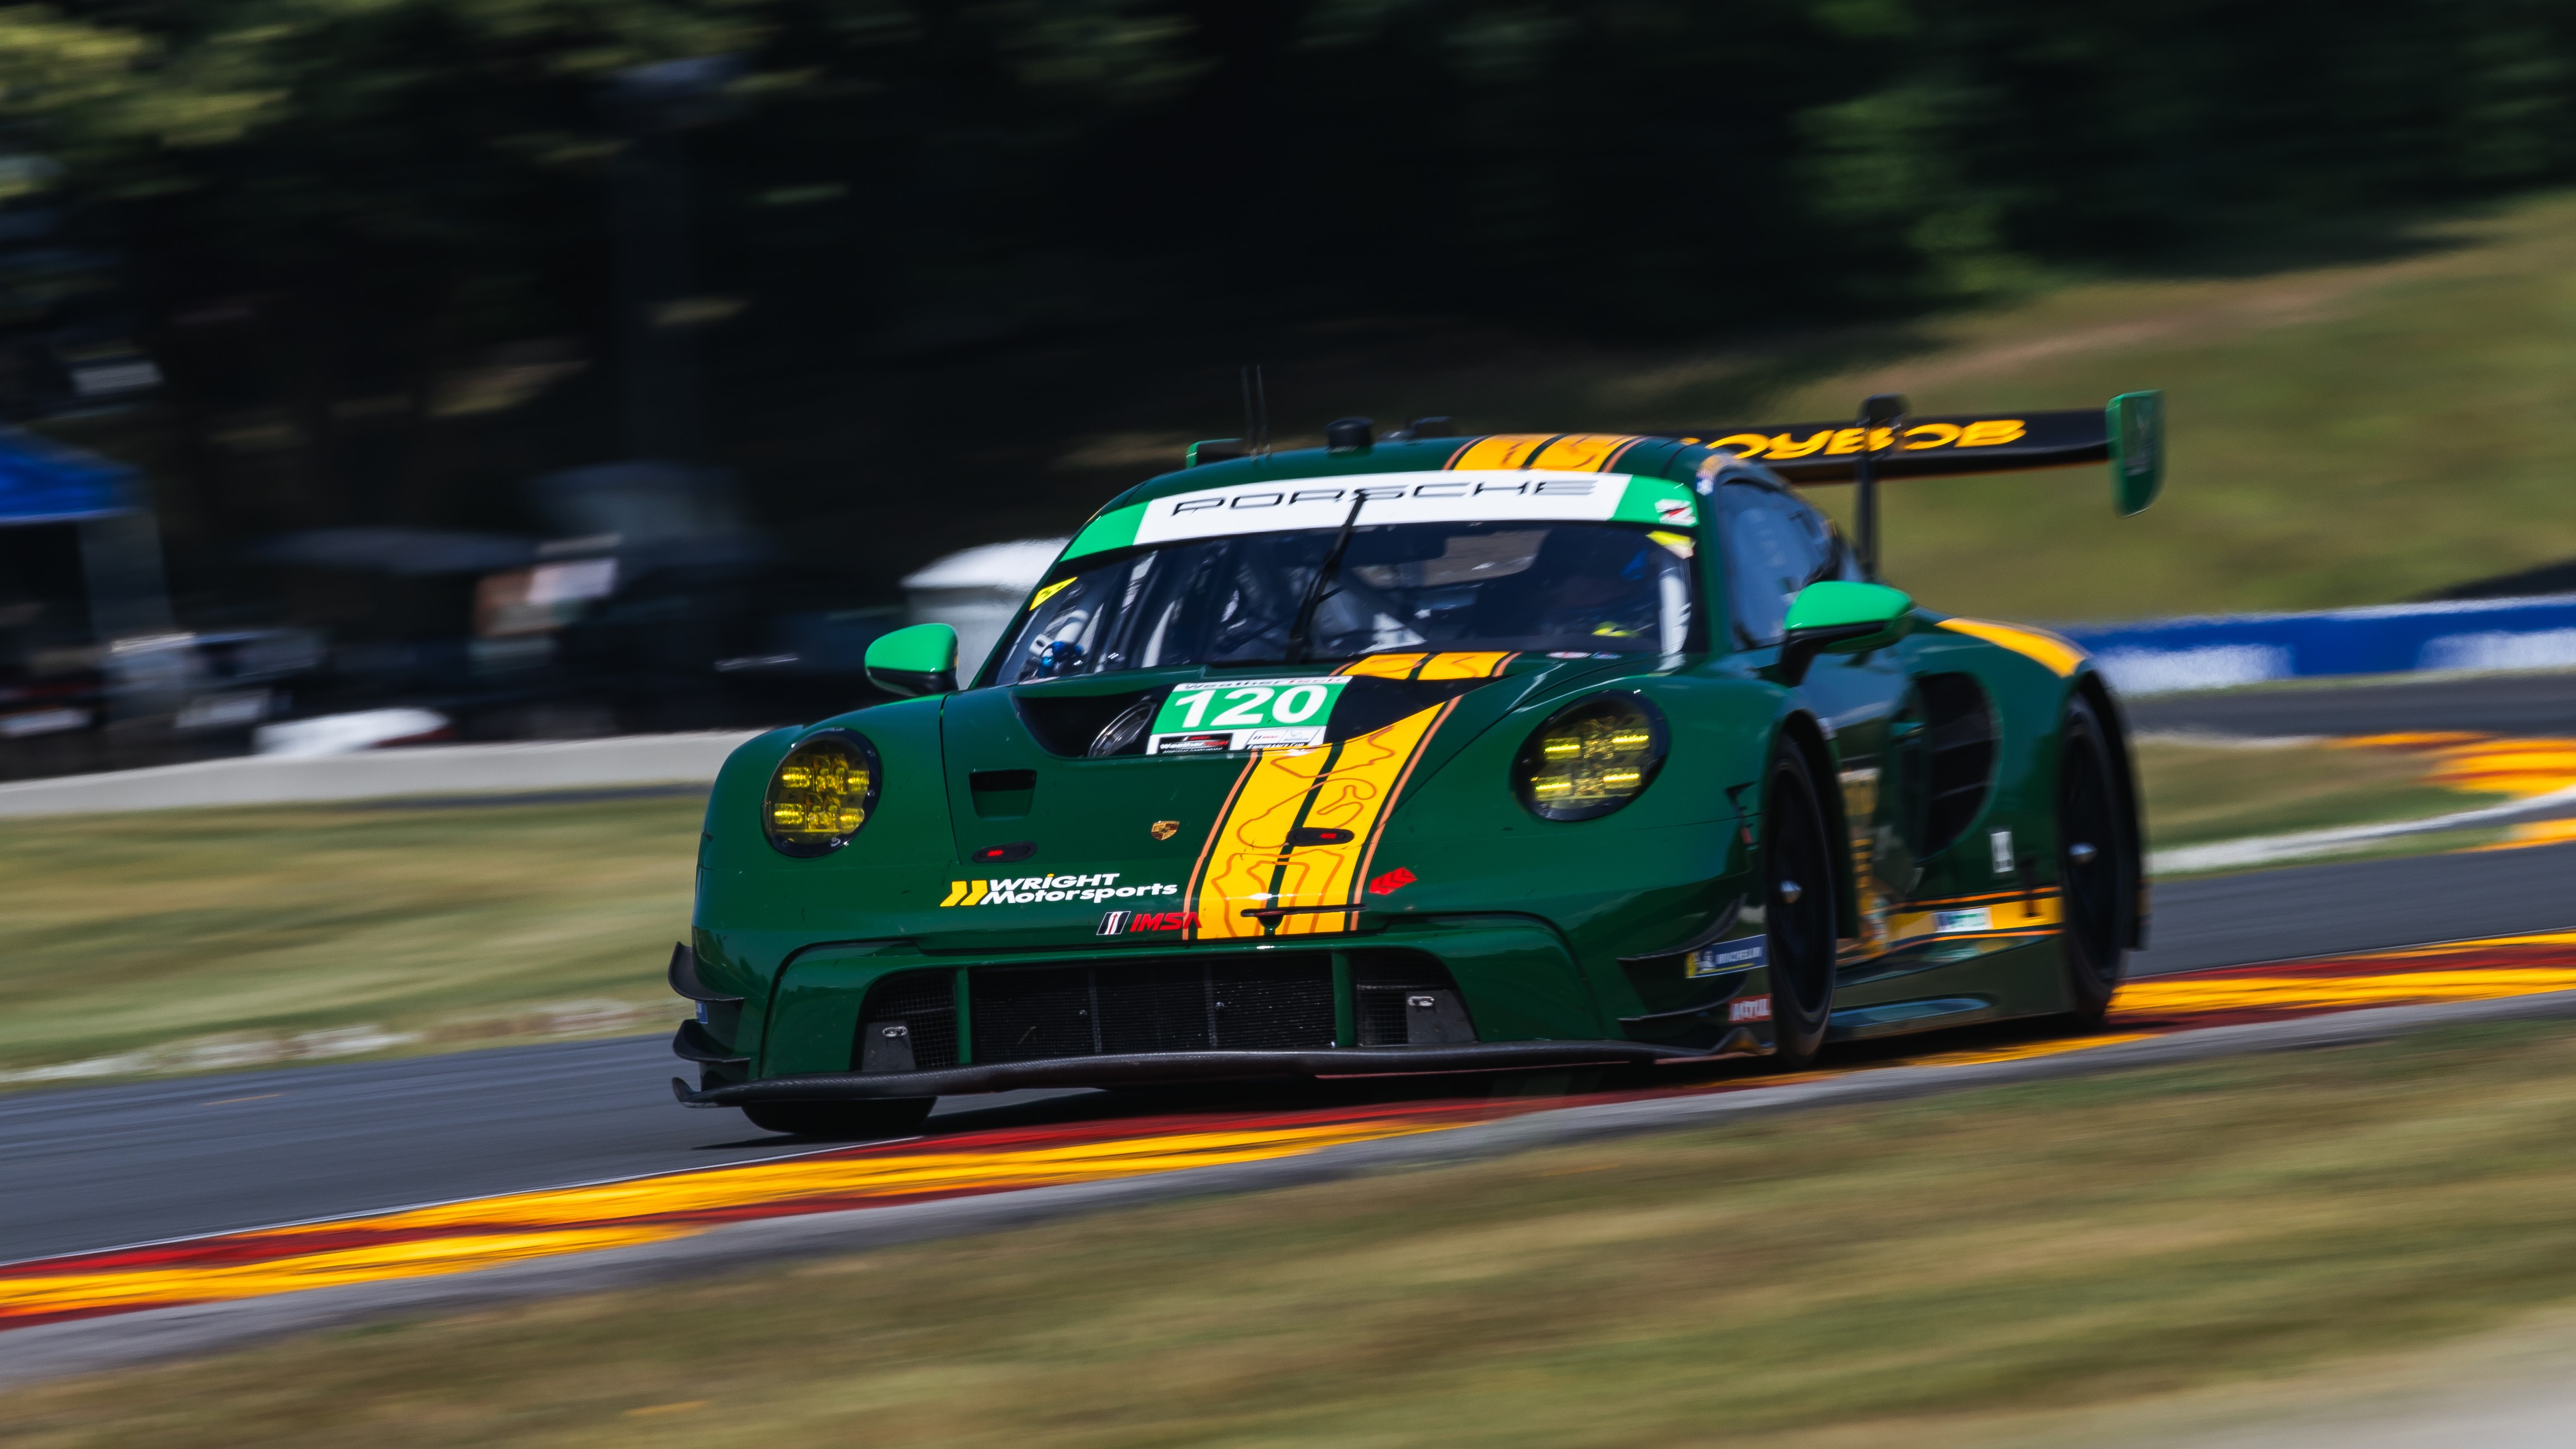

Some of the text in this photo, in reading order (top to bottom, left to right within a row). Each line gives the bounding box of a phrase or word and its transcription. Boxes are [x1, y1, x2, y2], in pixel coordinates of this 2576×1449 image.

[1680, 420, 2027, 460] OYBOB
[1170, 480, 1599, 516] PORSCHE
[1174, 684, 1328, 728] 120
[980, 883, 1178, 905] Motorsports
[1129, 912, 1203, 933] IMSA
